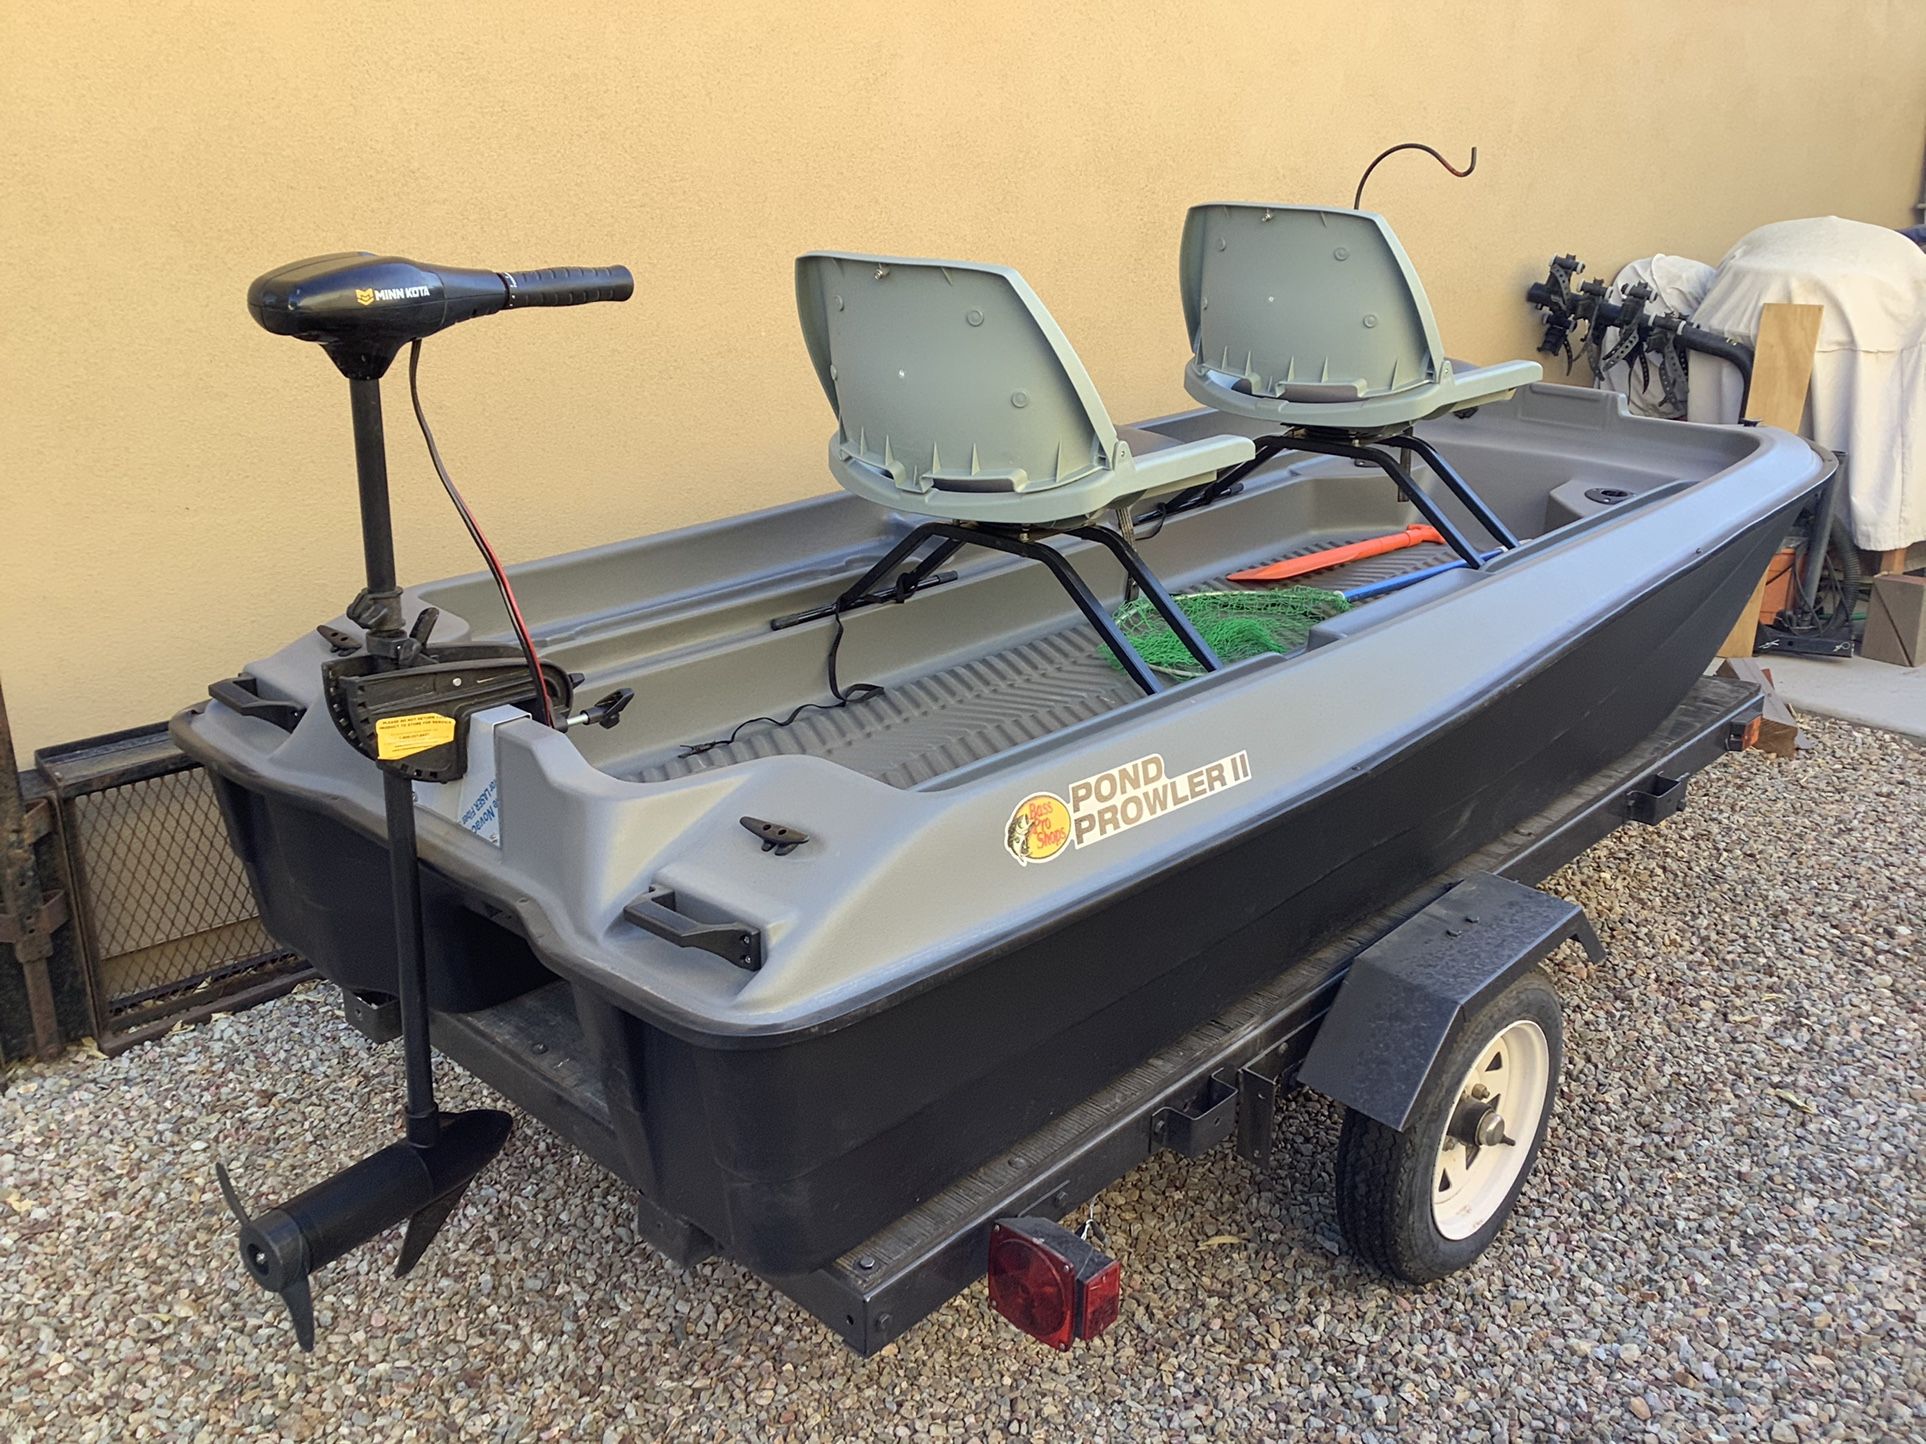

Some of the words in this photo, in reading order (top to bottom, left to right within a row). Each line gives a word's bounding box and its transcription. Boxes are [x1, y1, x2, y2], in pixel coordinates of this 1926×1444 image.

[374, 288, 405, 301] MINN
[405, 285, 430, 298] KOTA
[1071, 756, 1163, 813] POND
[473, 788, 492, 811] LASER
[1029, 801, 1053, 820] Bass
[1073, 762, 1227, 846] PROWLER
[1230, 753, 1249, 781] II
[1031, 817, 1052, 834] Pro
[1037, 827, 1066, 849] Shops
